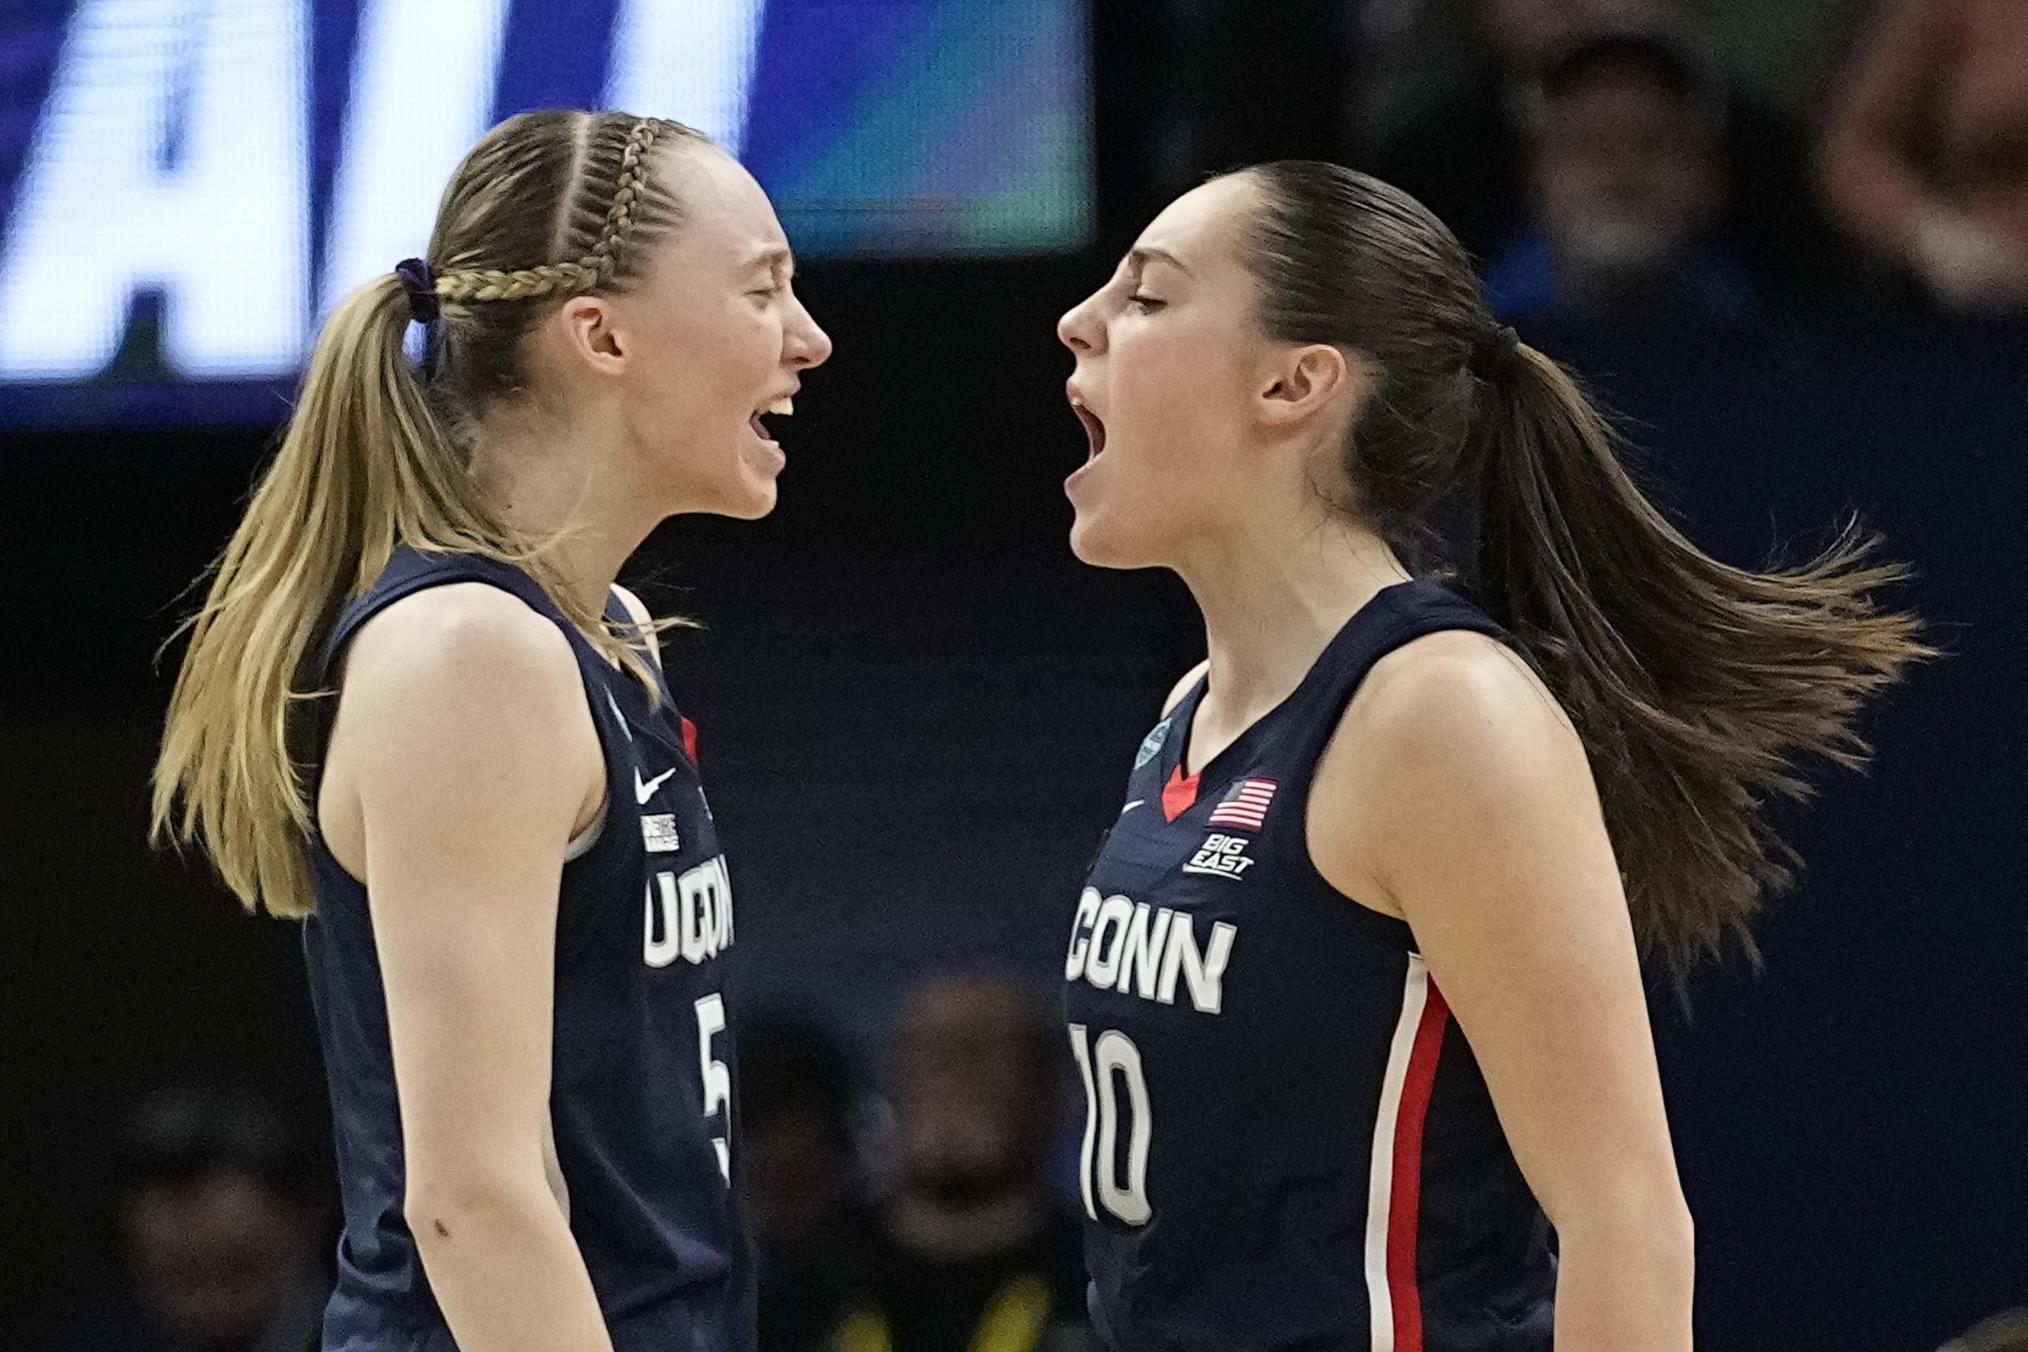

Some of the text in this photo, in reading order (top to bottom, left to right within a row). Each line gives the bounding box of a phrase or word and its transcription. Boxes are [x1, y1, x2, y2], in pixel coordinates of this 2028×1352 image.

[1202, 833, 1249, 855] BIG
[1189, 849, 1255, 873] EAST
[1067, 1024, 1152, 1226] 10
